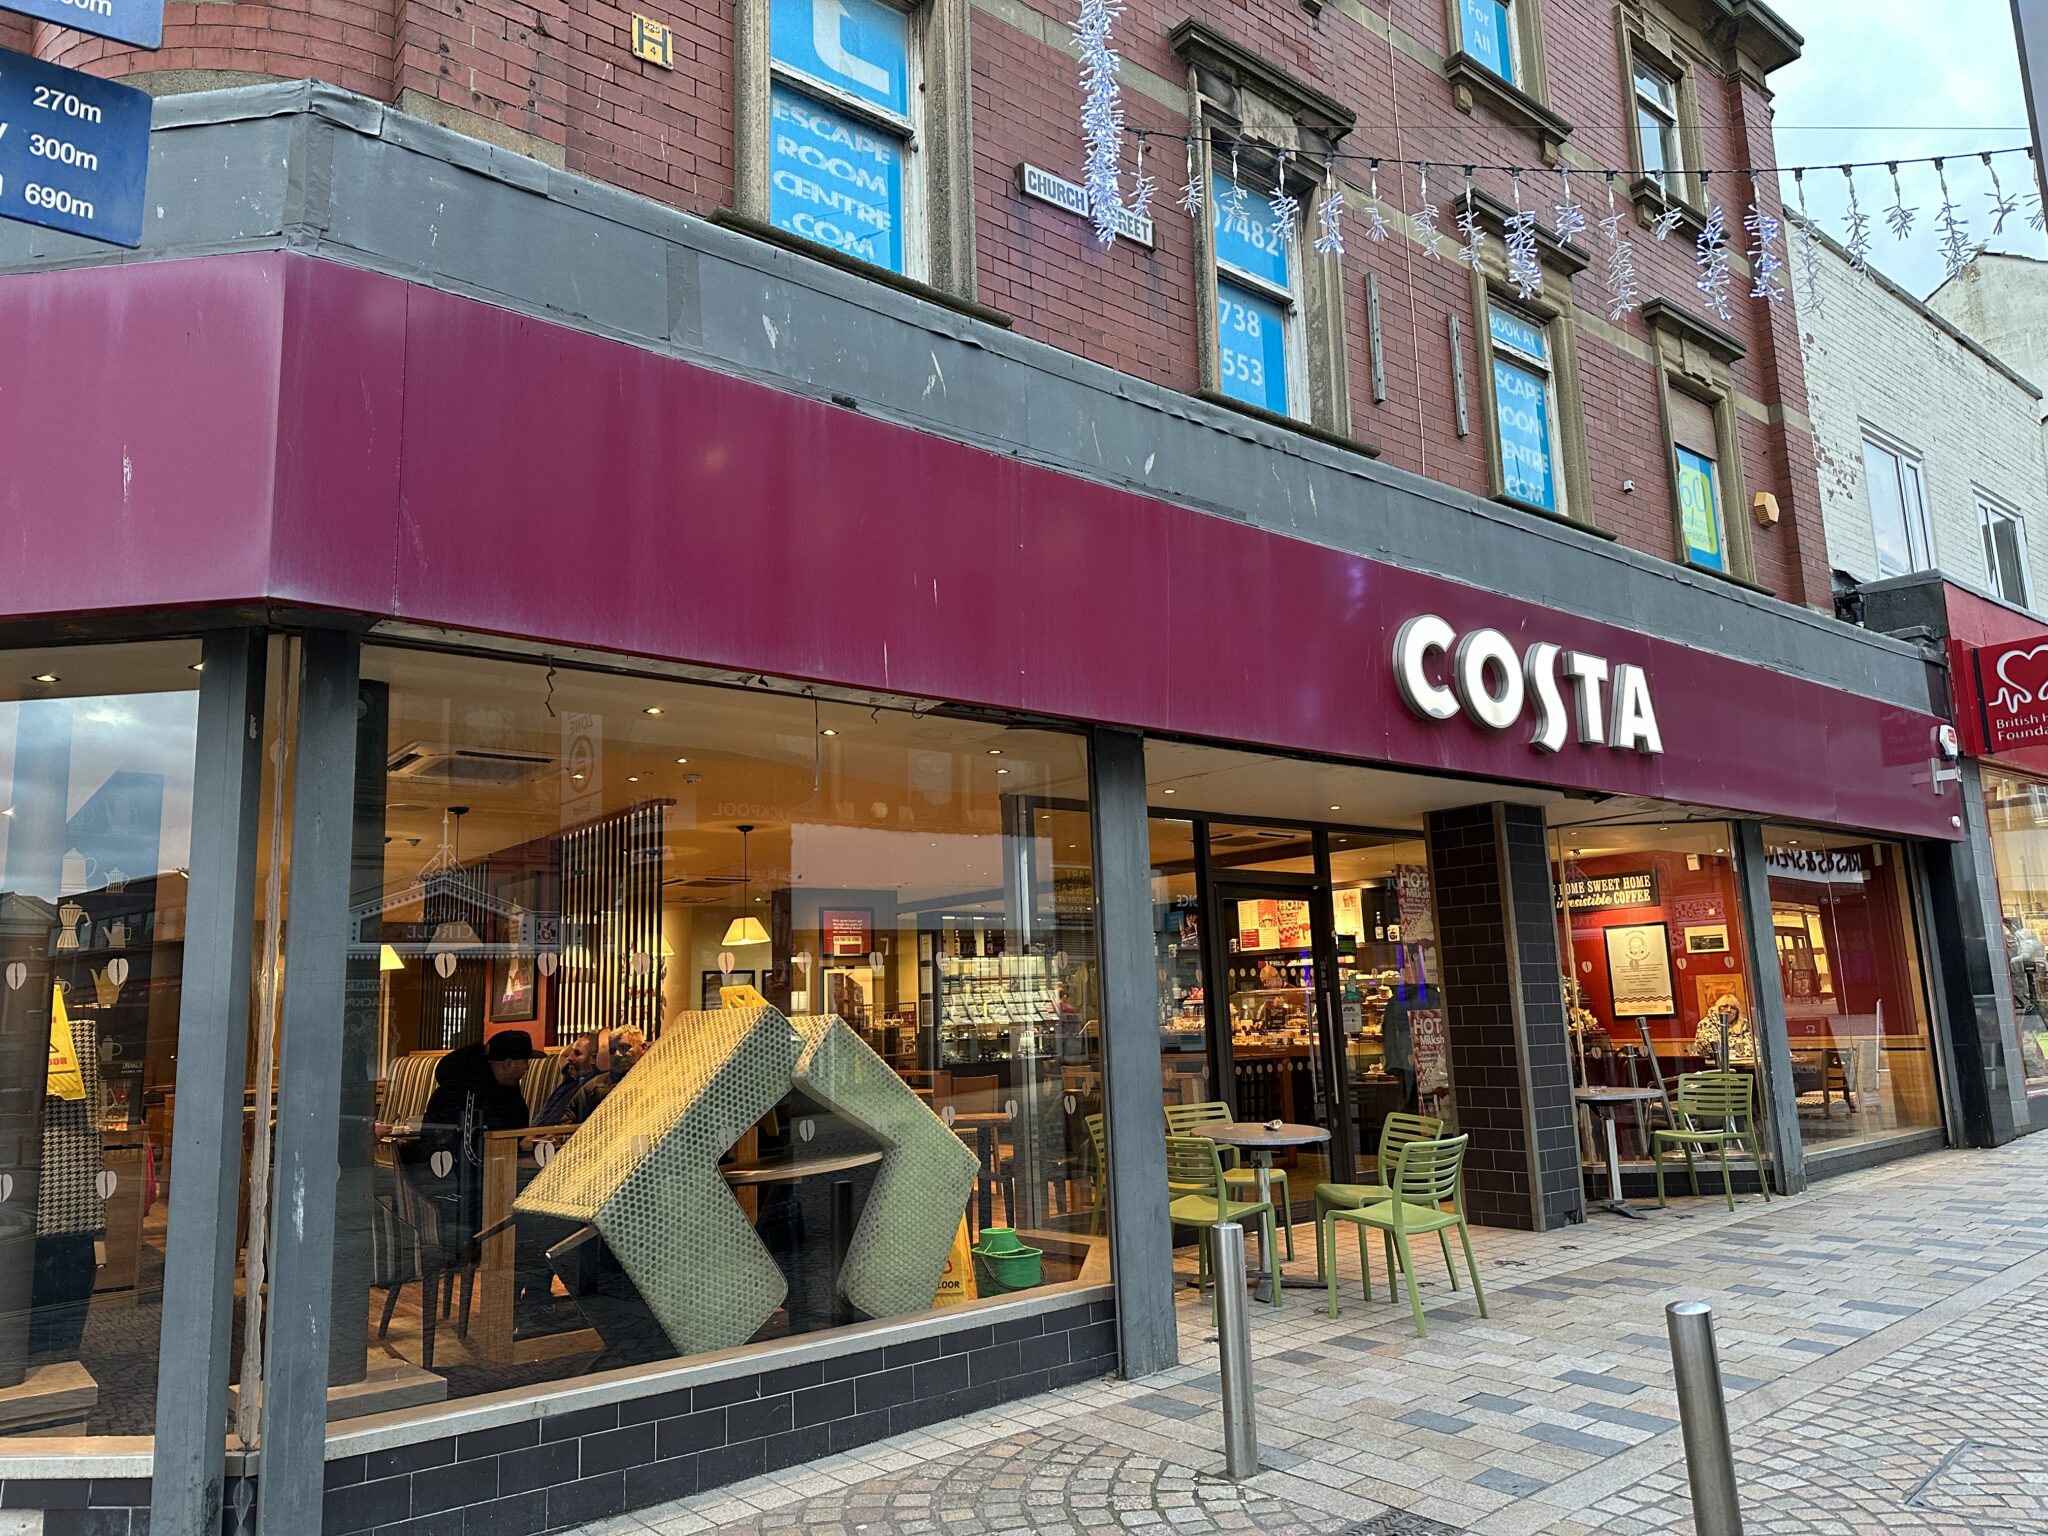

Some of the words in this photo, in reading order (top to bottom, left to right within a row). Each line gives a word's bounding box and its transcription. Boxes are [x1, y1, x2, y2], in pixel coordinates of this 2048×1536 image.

[1467, 0, 1489, 27] For
[650, 46, 657, 56] 4
[1473, 29, 1491, 55] All
[33, 85, 102, 124] 270m
[772, 97, 891, 166] ESCAPE
[29, 133, 99, 172] 300m
[776, 133, 888, 198] ROOM
[24, 182, 94, 220] 690m
[772, 169, 892, 232] CENTRE
[1027, 170, 1086, 212] CHURCH
[781, 212, 875, 260] .COM
[1218, 296, 1261, 338] 738
[1488, 312, 1522, 342] BOOK
[1523, 330, 1536, 348] AT
[1222, 347, 1263, 387] 553
[1495, 368, 1543, 406] SCAPE
[1499, 404, 1544, 440] OOM
[1501, 437, 1549, 474] ENTRE
[1392, 613, 1665, 755] COSTA
[1996, 714, 2039, 729] British
[1400, 871, 1428, 888] HOT
[1586, 878, 1621, 893] SWEET
[1622, 875, 1651, 889] HOME
[1613, 889, 1651, 904] COFFEE
[1413, 1017, 1442, 1035] HOT
[937, 1280, 960, 1289] LOOR
